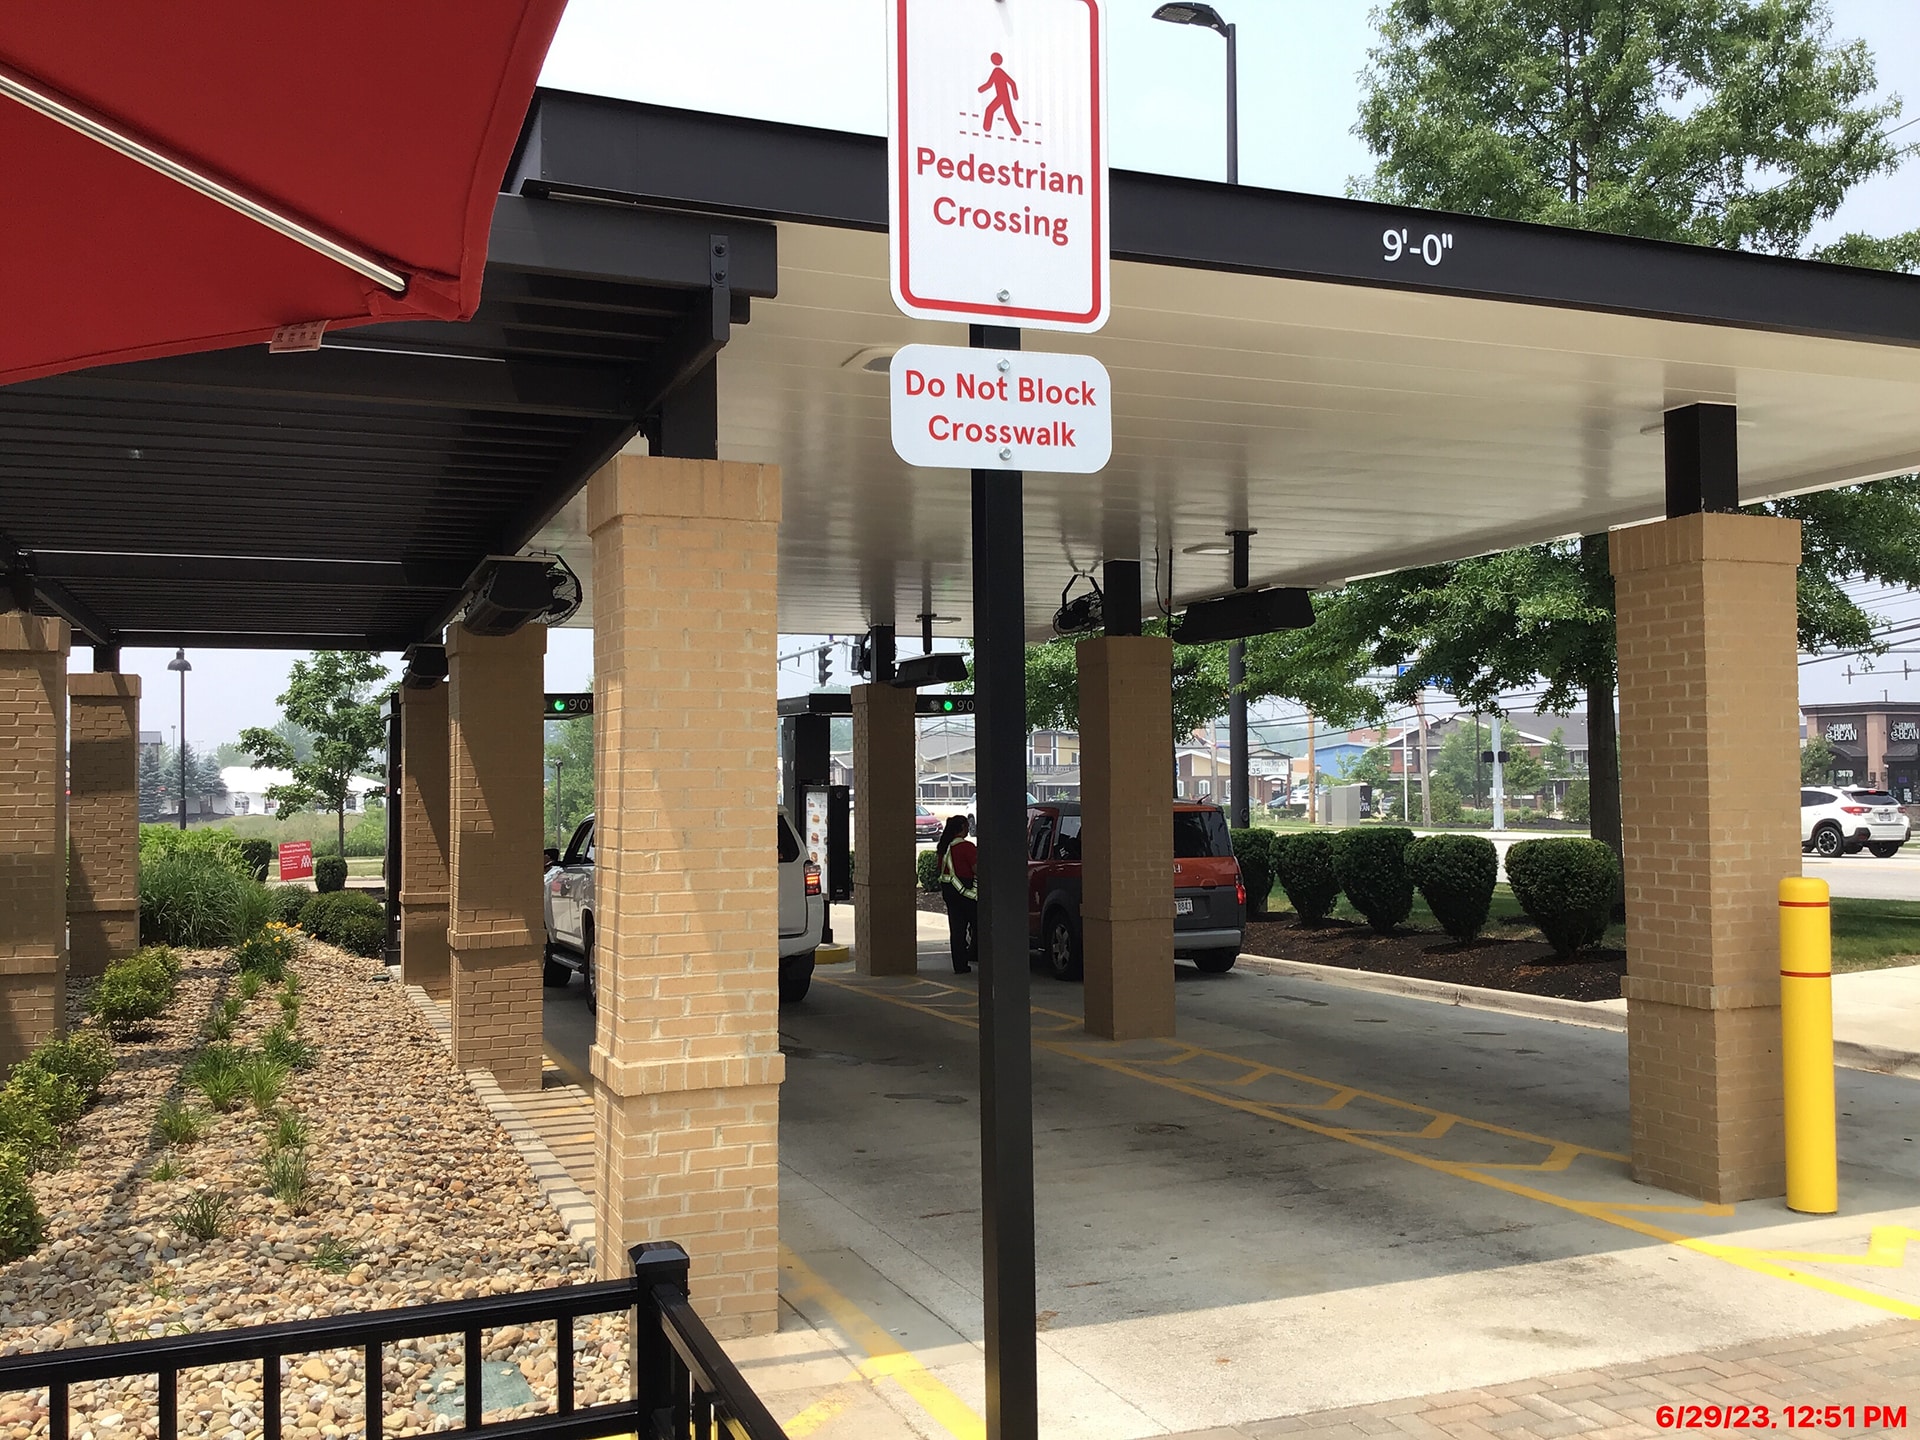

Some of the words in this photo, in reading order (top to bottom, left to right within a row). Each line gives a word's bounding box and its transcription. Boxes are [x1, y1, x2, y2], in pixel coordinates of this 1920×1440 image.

[917, 146, 1084, 195] Pedestrian
[933, 196, 1069, 246] Crossing
[1382, 228, 1453, 266] 9'-0"
[905, 369, 946, 397] Do
[956, 372, 1008, 401] Not
[1018, 376, 1097, 406] Block
[928, 414, 1076, 448] Crosswalk
[957, 700, 974, 711] 9'0
[1833, 723, 1853, 731] HUMAN
[1834, 729, 1857, 741] BEAN
[1898, 728, 1920, 740] BEAN
[1251, 767, 1261, 775] 35
